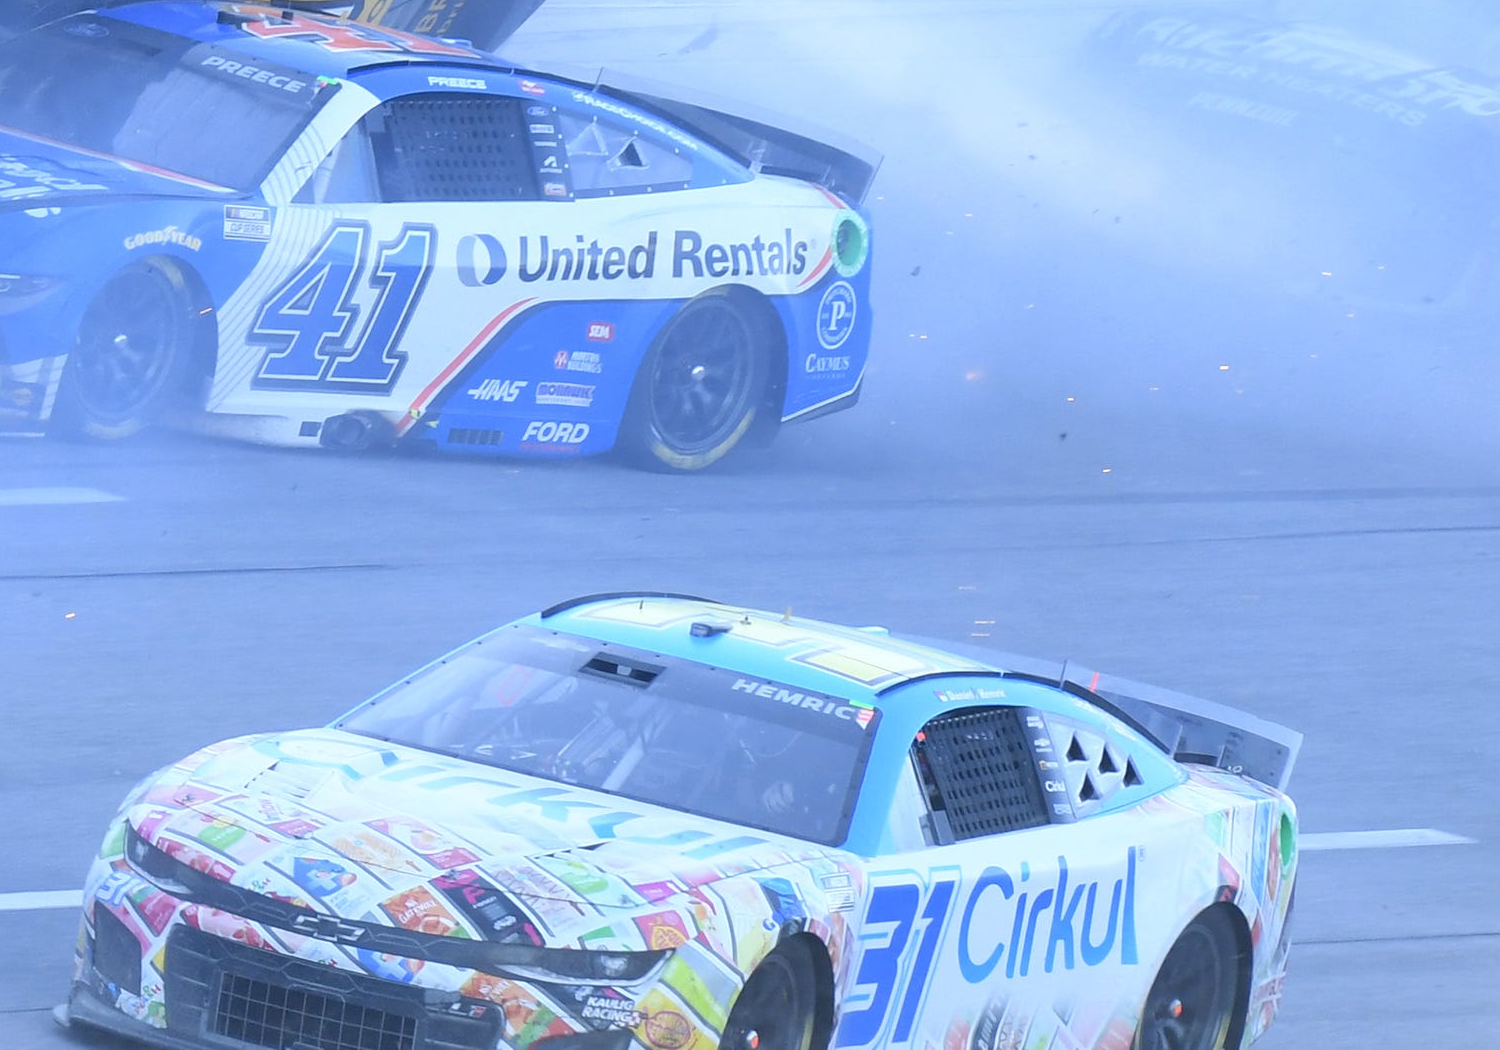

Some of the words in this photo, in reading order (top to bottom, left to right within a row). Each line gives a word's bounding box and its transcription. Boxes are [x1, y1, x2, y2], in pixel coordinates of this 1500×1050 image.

[201, 55, 307, 93] PREECE
[427, 76, 487, 90] PREECE
[124, 225, 202, 252] GOODYEAR
[518, 230, 658, 283] United
[671, 228, 809, 279] Rentals
[245, 217, 440, 396] 41
[805, 353, 851, 373] CAYMUS
[467, 379, 529, 402] HAAS
[522, 421, 590, 444] FORD
[731, 678, 856, 721] HEMRIC
[399, 897, 439, 926] GATEWAY
[957, 846, 1139, 984] Cirkul
[834, 865, 963, 1050] 31
[581, 1006, 633, 1022] RACING
[586, 996, 636, 1011] KAULIG
